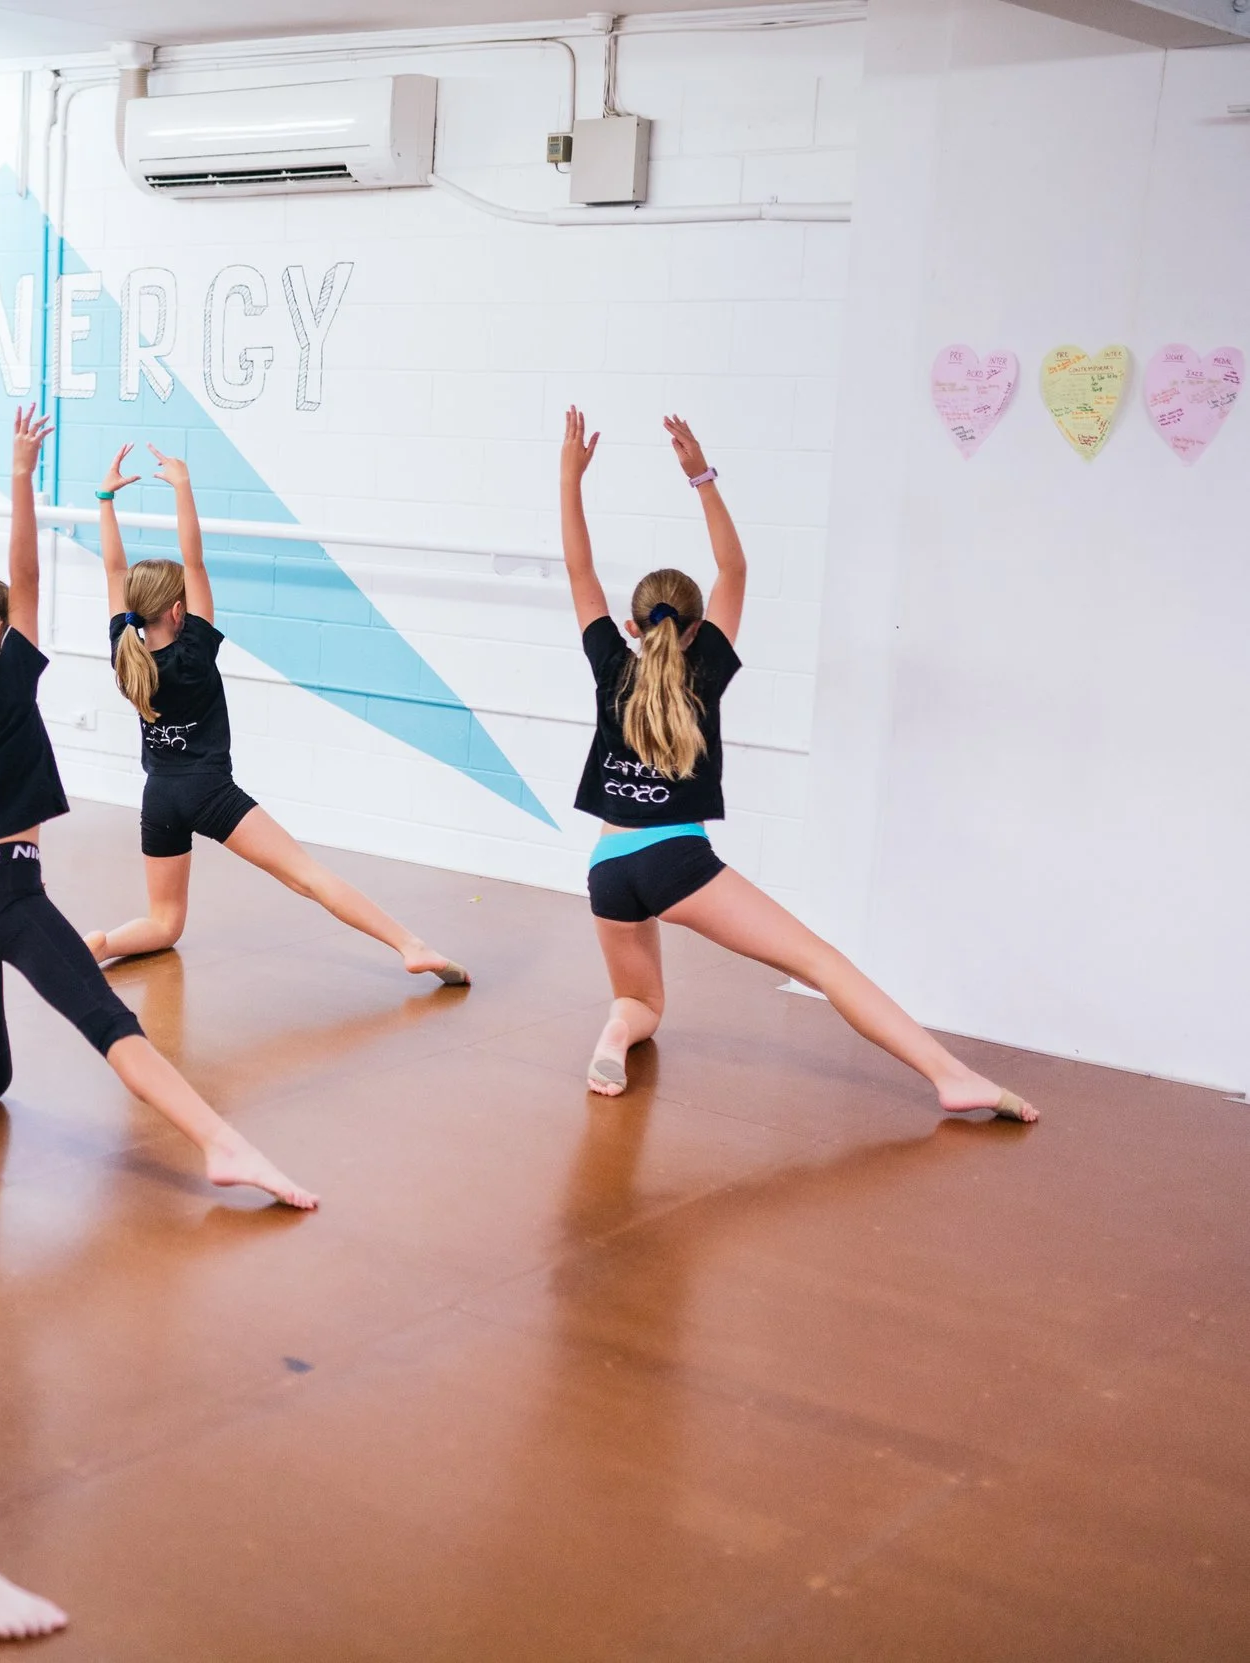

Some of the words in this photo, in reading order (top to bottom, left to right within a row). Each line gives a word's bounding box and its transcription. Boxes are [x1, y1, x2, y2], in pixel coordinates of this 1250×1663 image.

[949, 351, 963, 361] PRE
[989, 356, 1007, 366] INTER
[1056, 351, 1069, 359] PRE
[605, 779, 669, 802] 2020
